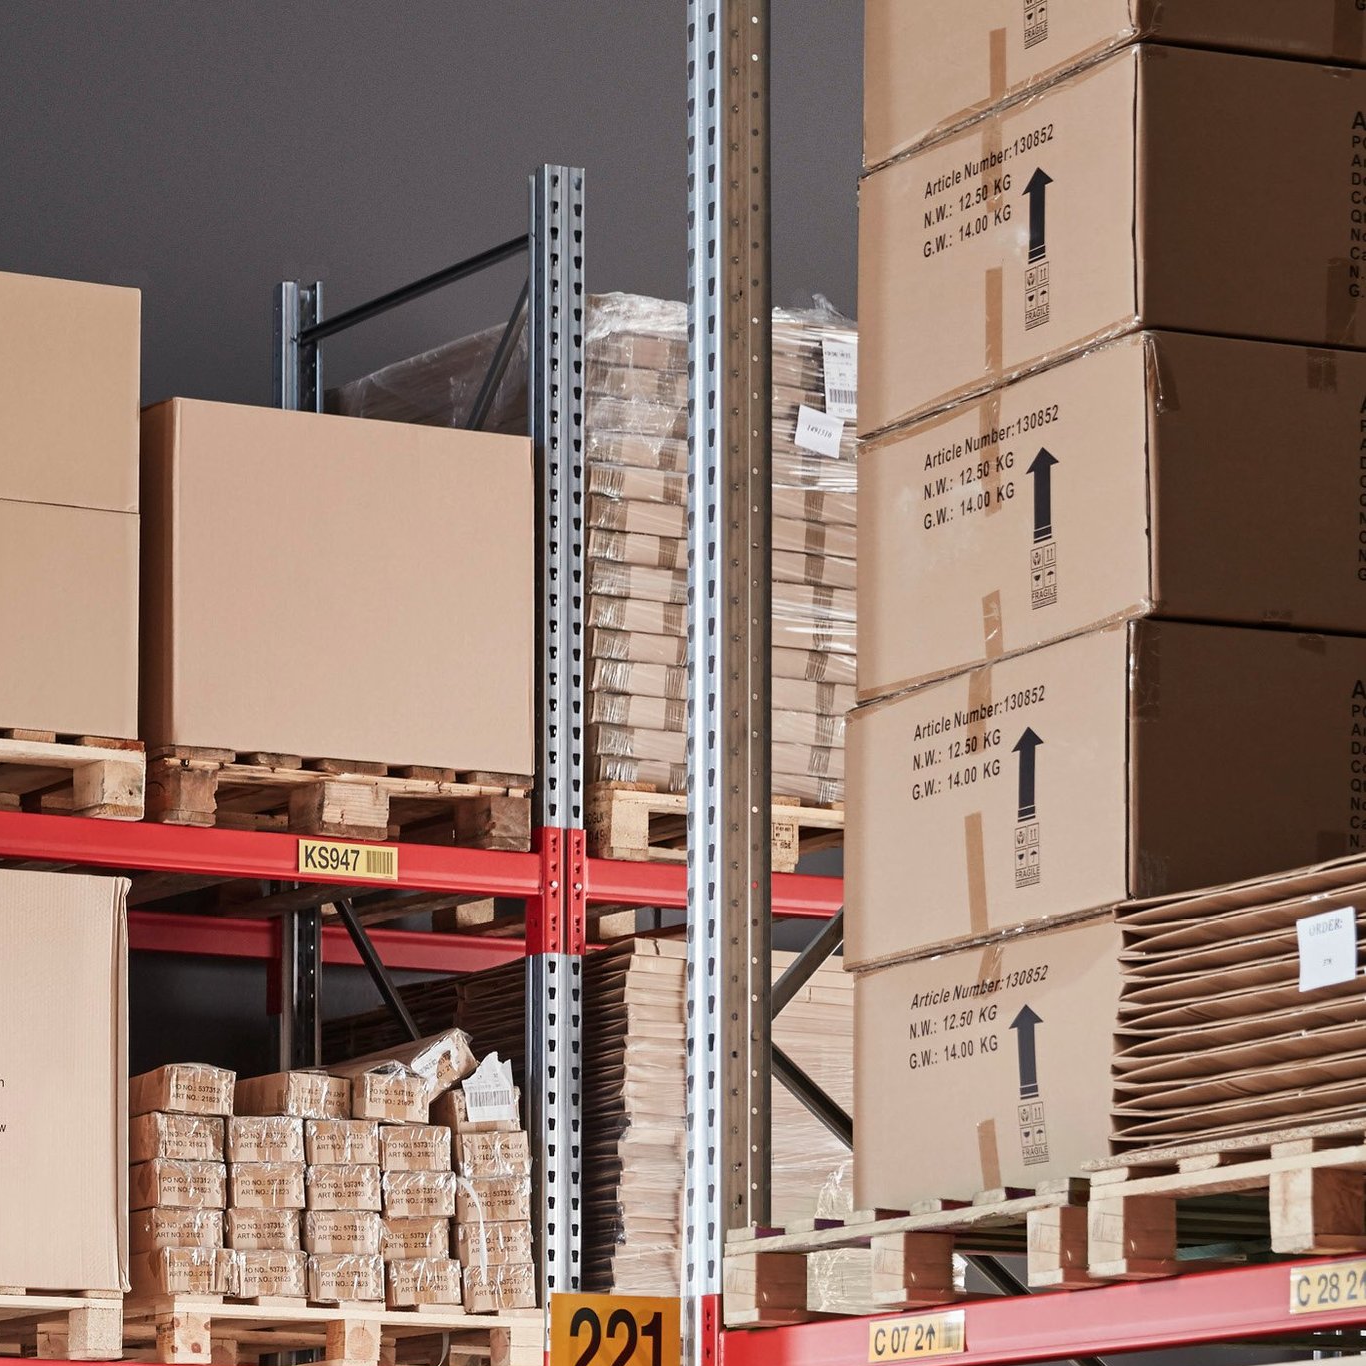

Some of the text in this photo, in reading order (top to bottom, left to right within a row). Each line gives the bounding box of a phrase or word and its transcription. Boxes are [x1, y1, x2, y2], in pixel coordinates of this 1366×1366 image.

[924, 170, 961, 199] Article
[924, 174, 1011, 229] N.W.: 12.50 KG
[923, 205, 1011, 258] G.W.: 14.00 KG
[1025, 305, 1049, 322] FRAGILE
[924, 444, 961, 470] Article
[924, 452, 1014, 500] N.W.: 12.50 KG
[924, 482, 1014, 529] G.W.: 14.00 KG
[1032, 586, 1057, 600] FRAGILE
[914, 716, 950, 741] Article
[913, 729, 1001, 771] N.W.: 12.50 KG
[912, 759, 1000, 800] G.W.: 14.00 KG
[305, 846, 360, 871] KS947
[1015, 866, 1040, 879] FRAGILE
[911, 988, 950, 1010] Article
[909, 1004, 997, 1039] N.W.: 12.50 KG
[909, 1035, 998, 1069] G.W.: 14.00 KG
[1022, 1144, 1049, 1157] FRAGILE
[1298, 1270, 1357, 1306] C 28 2
[875, 1324, 924, 1355] C 07 2
